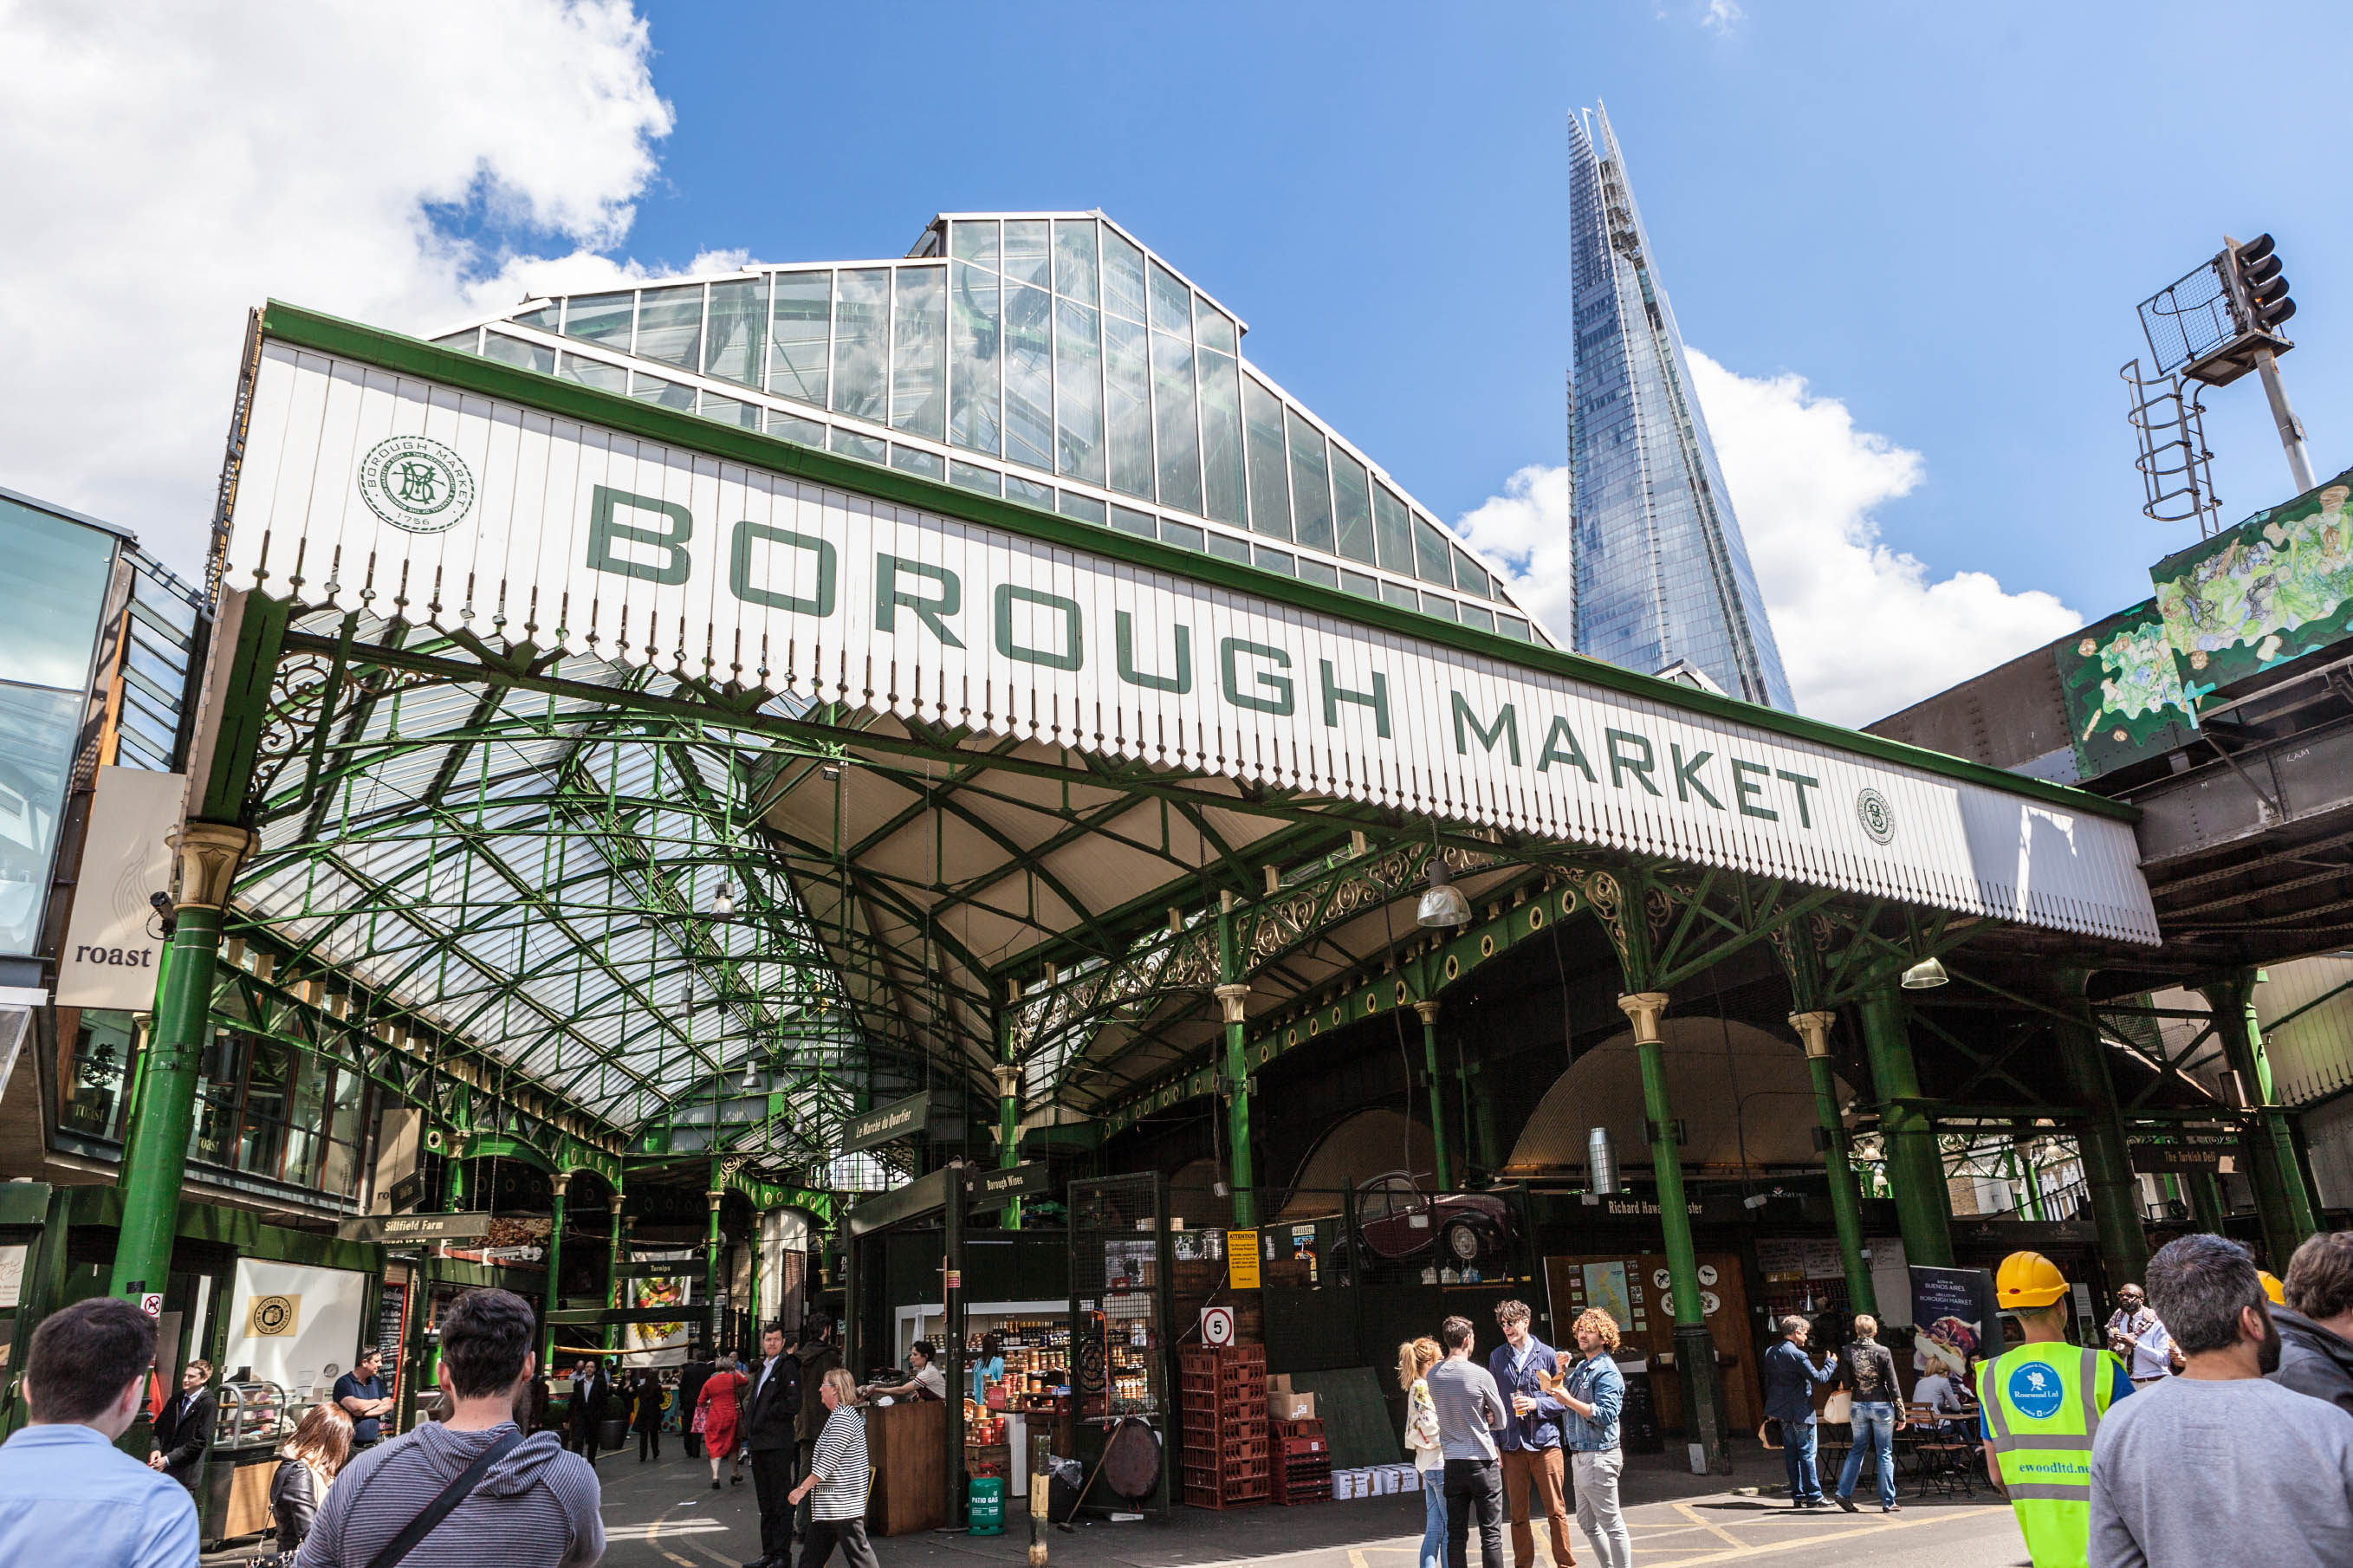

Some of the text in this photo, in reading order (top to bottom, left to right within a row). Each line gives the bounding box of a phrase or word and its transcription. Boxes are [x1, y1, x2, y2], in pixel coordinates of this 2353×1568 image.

[367, 442, 467, 508] BOROUGH MARKET
[397, 512, 430, 525] 1756
[587, 484, 1819, 829] BOROUGH MARKET
[75, 944, 152, 968] roast
[856, 1109, 911, 1138] Le Marché du Quartier
[2165, 1151, 2215, 1162] The Turkish Deli
[986, 1175, 1024, 1191] Borough Wines
[1608, 1201, 1702, 1214] Richard Hawa ster
[385, 1220, 444, 1232] Sillfield Farm
[260, 1299, 288, 1311] AUTHENTIC
[1214, 1320, 1222, 1335] 5
